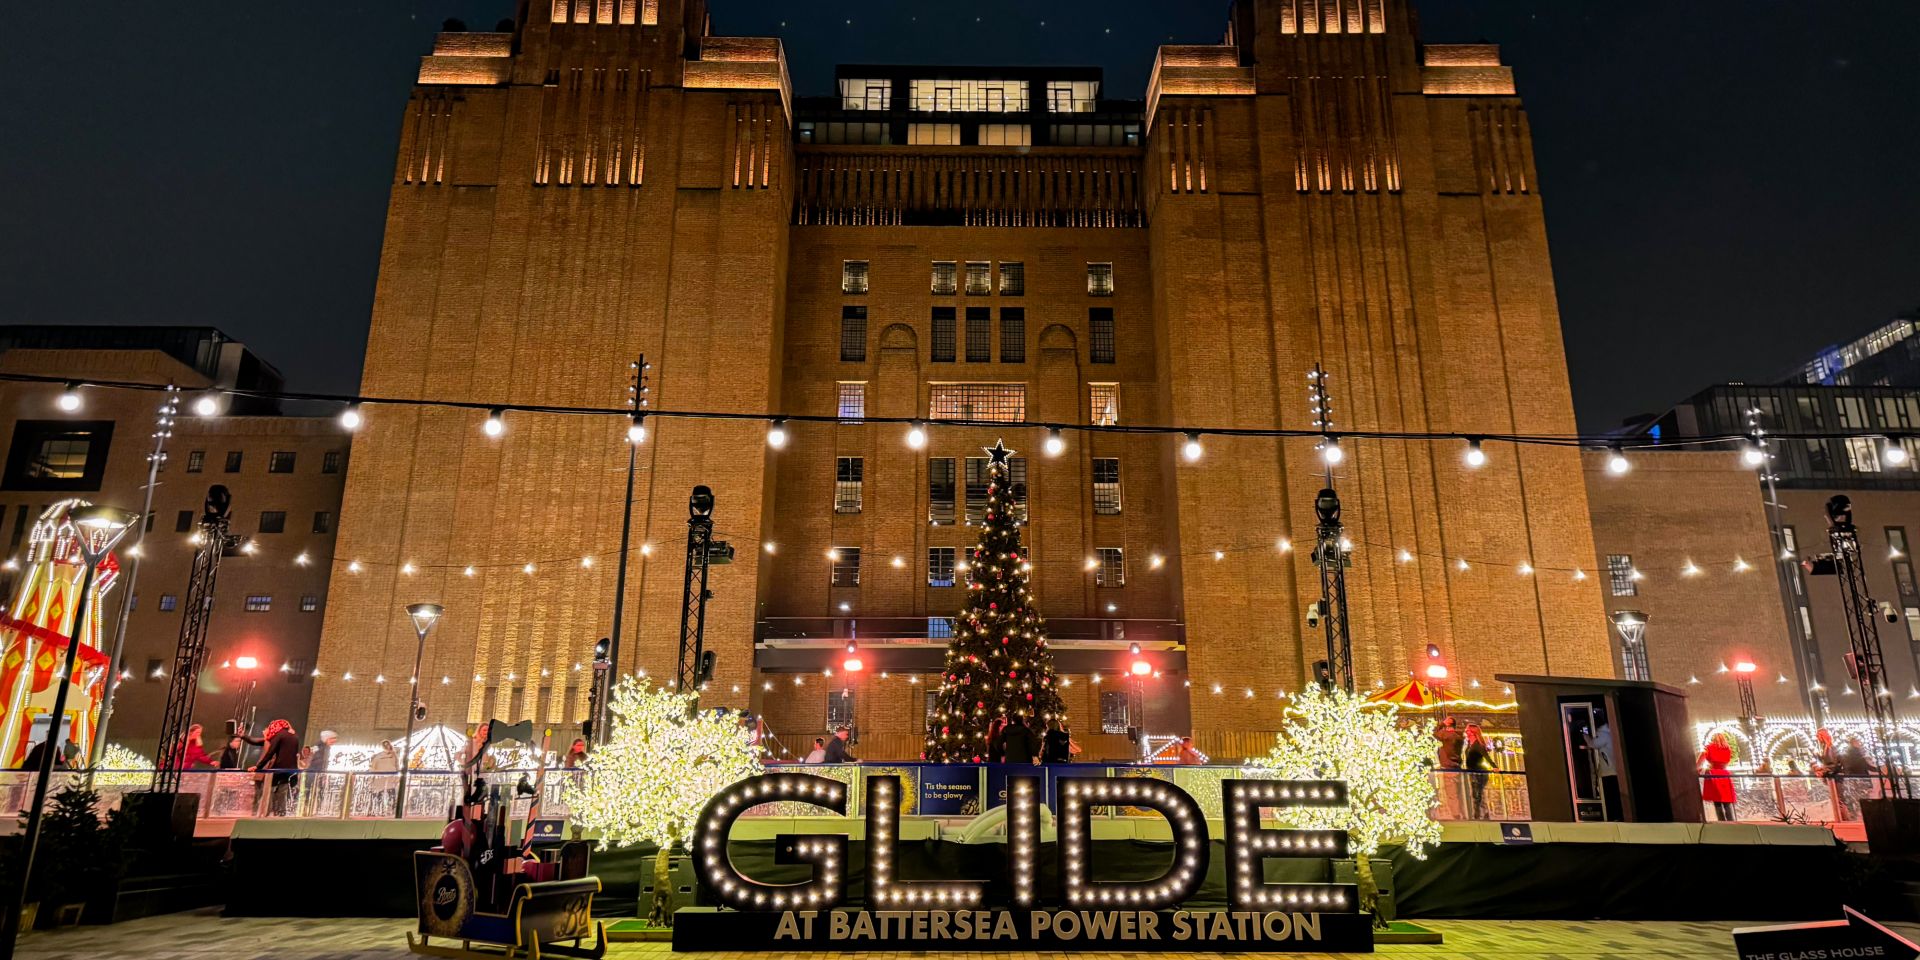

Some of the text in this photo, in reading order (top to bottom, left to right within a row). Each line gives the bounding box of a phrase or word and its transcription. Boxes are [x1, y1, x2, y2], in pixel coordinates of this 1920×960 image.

[936, 782, 947, 790] the
[933, 791, 942, 799] be
[942, 791, 964, 801] glowy
[690, 772, 1360, 914] GLIDE
[773, 909, 1322, 941] AT BATTERSEA POWER STATION
[1778, 949, 1828, 960] GLASS
[1831, 946, 1885, 958] HOUSE
